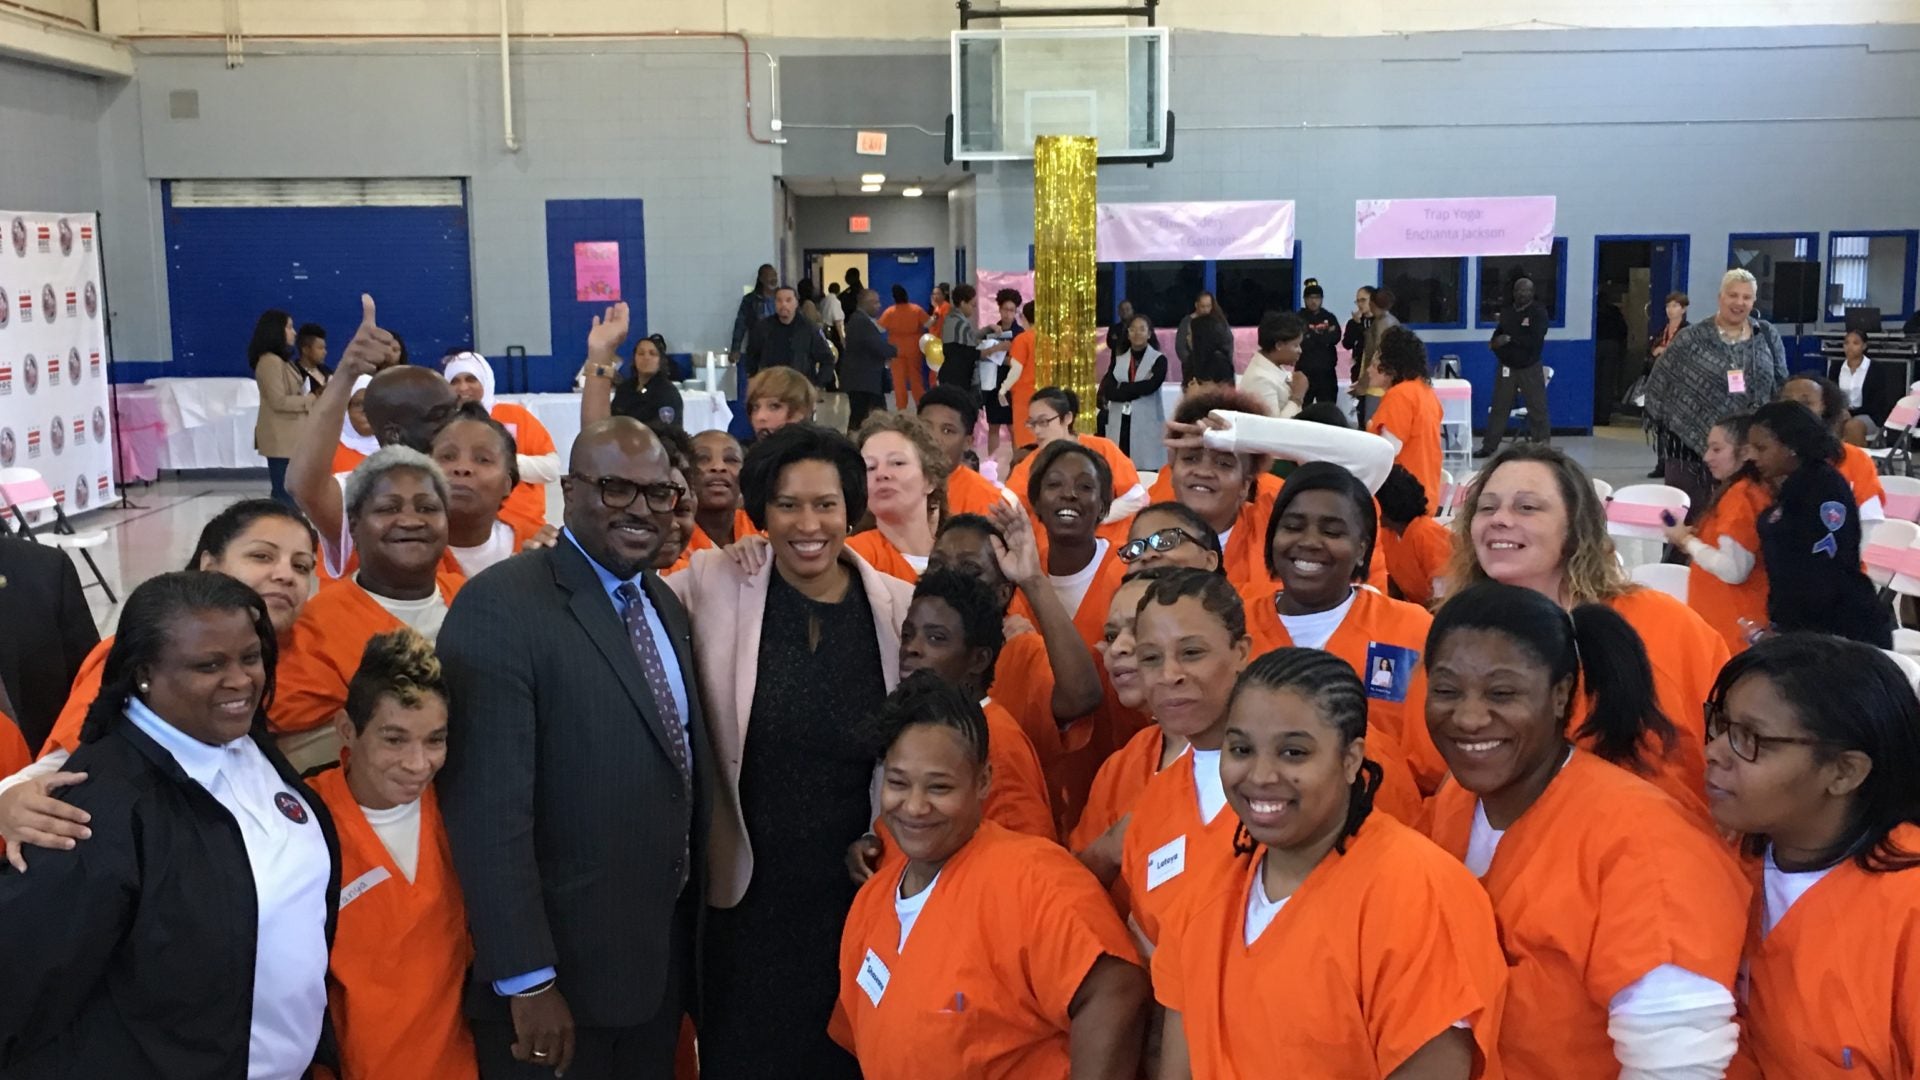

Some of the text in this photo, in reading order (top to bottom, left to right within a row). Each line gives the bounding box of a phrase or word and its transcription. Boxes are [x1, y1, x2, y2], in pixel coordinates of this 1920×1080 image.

[1424, 208, 1450, 222] Trap
[1405, 227, 1505, 242] Enchanta Jackson
[341, 881, 368, 904] anya
